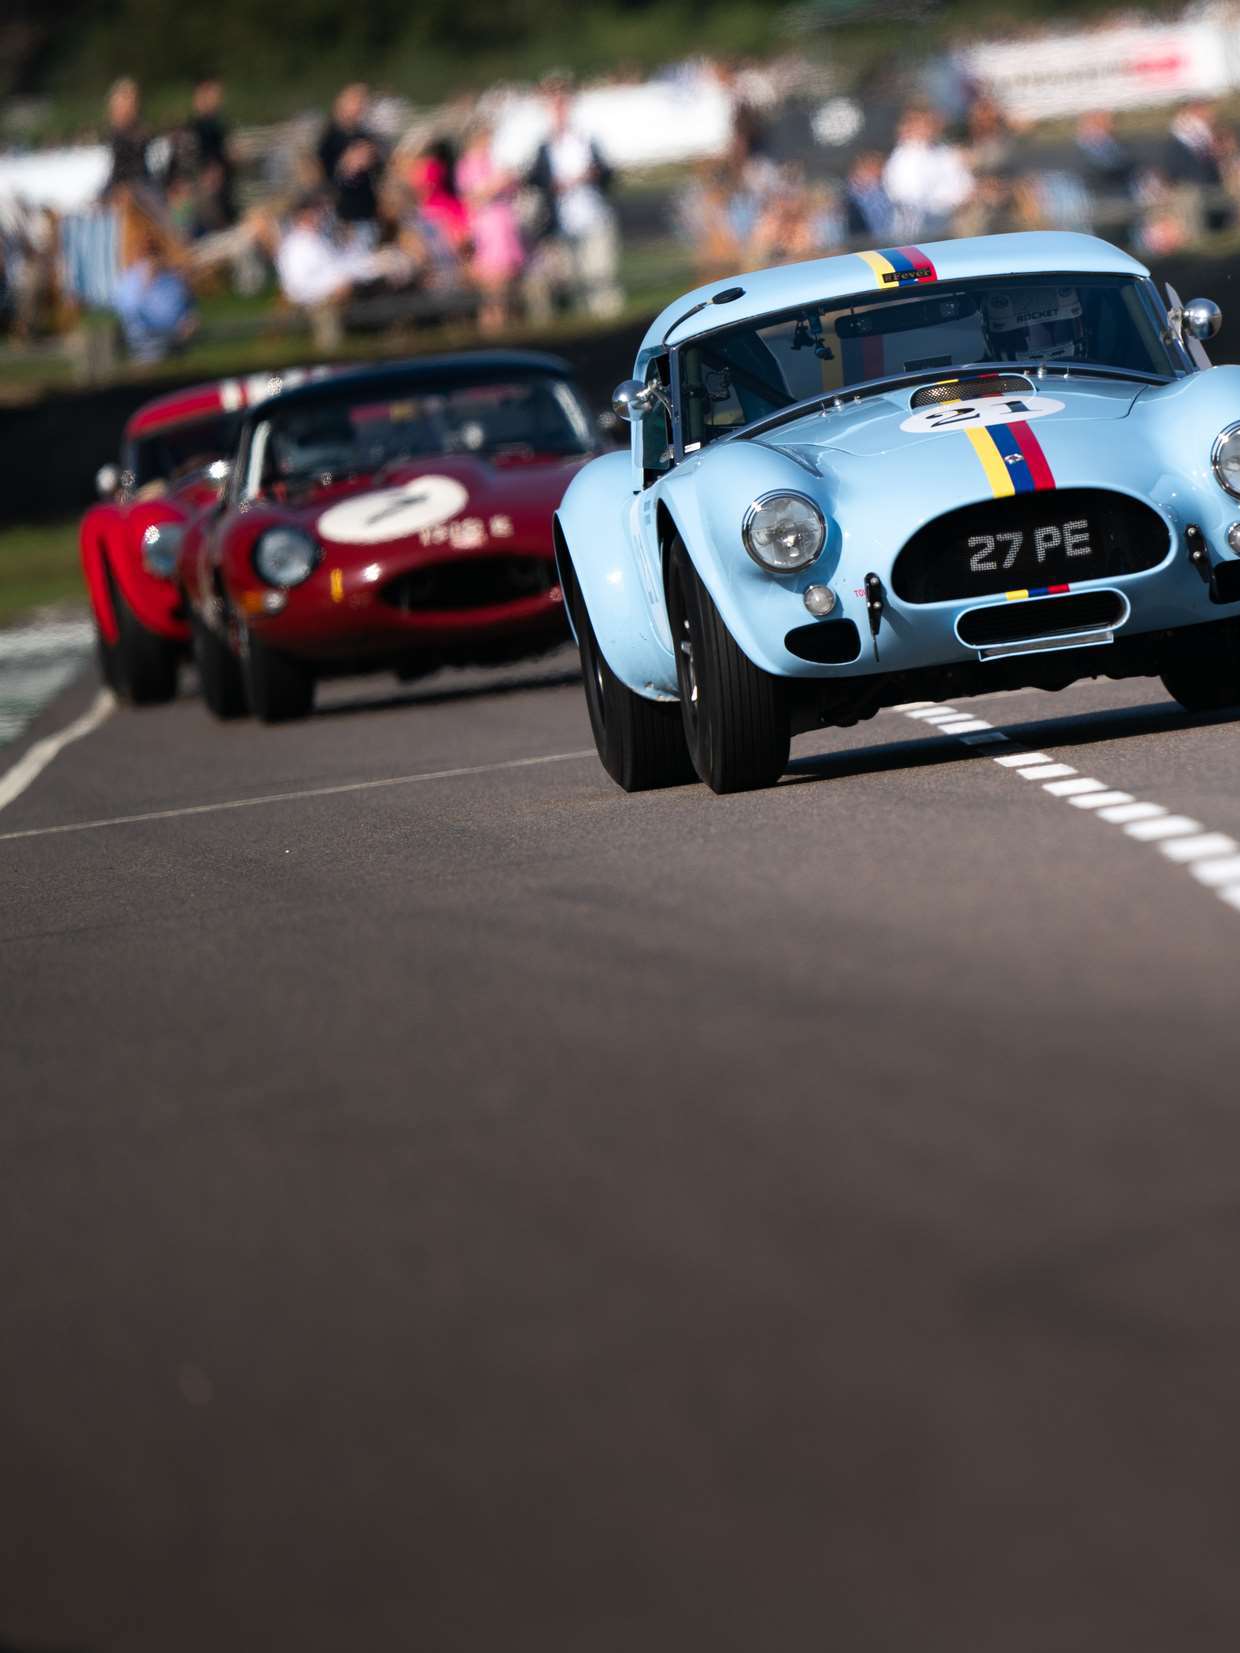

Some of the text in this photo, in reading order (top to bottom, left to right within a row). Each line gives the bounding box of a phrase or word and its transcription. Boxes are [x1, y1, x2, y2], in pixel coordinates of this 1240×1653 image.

[925, 400, 1044, 428] 21
[967, 519, 1092, 572] 27 PE
